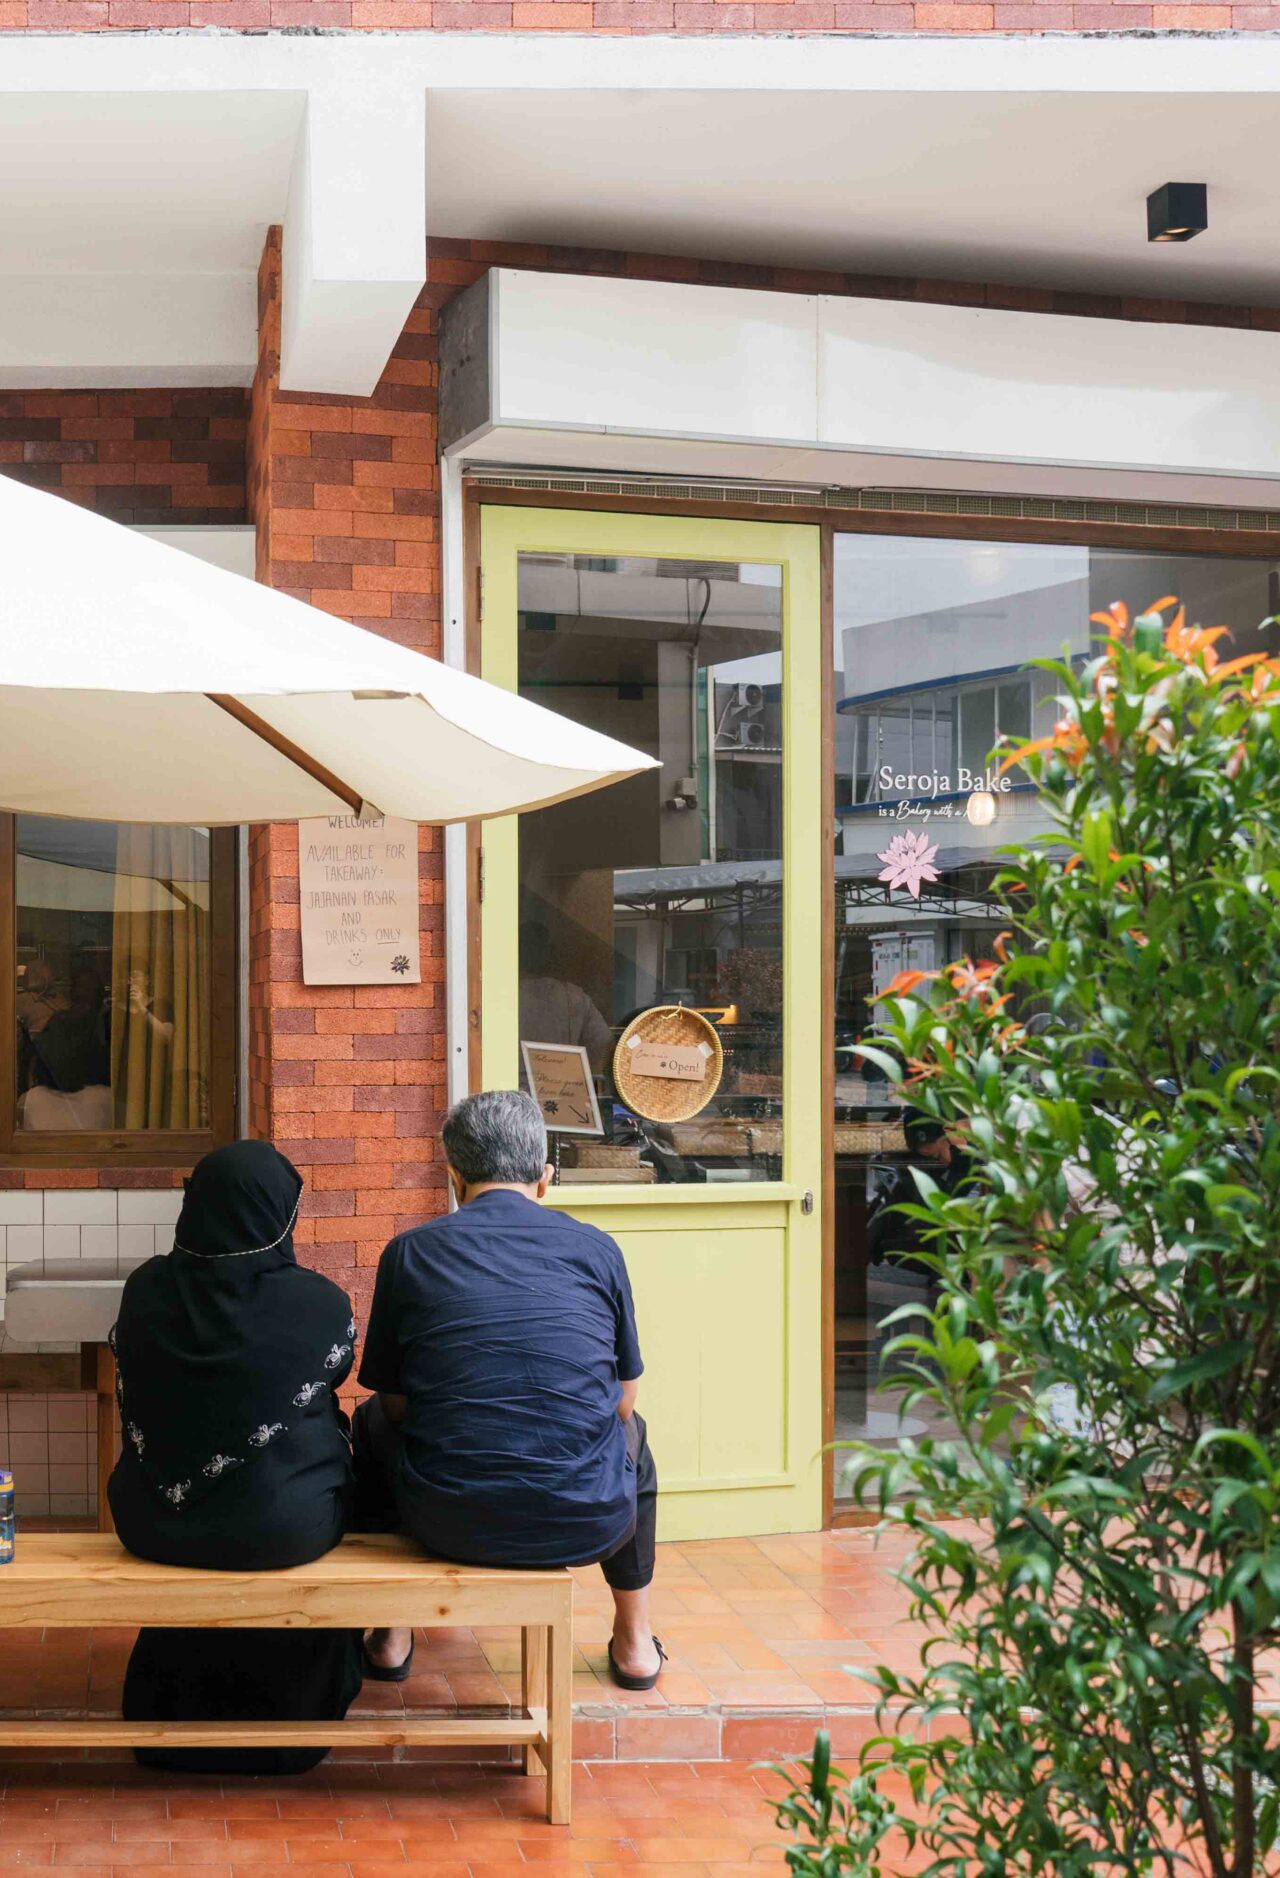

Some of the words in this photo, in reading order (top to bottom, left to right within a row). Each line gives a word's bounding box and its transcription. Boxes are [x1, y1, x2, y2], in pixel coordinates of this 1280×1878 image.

[879, 766, 951, 800] Seroja
[957, 767, 1011, 792] Bake
[879, 805, 887, 817] is
[889, 809, 895, 817] a
[307, 844, 374, 862] AVAILABLE
[385, 844, 406, 860] FOR
[306, 891, 356, 910] JAJANAN
[363, 890, 397, 906] PASAR
[341, 912, 361, 926] AND
[326, 929, 367, 946] DRINKS
[376, 928, 401, 941] ONLY
[669, 1060, 699, 1074] Open!
